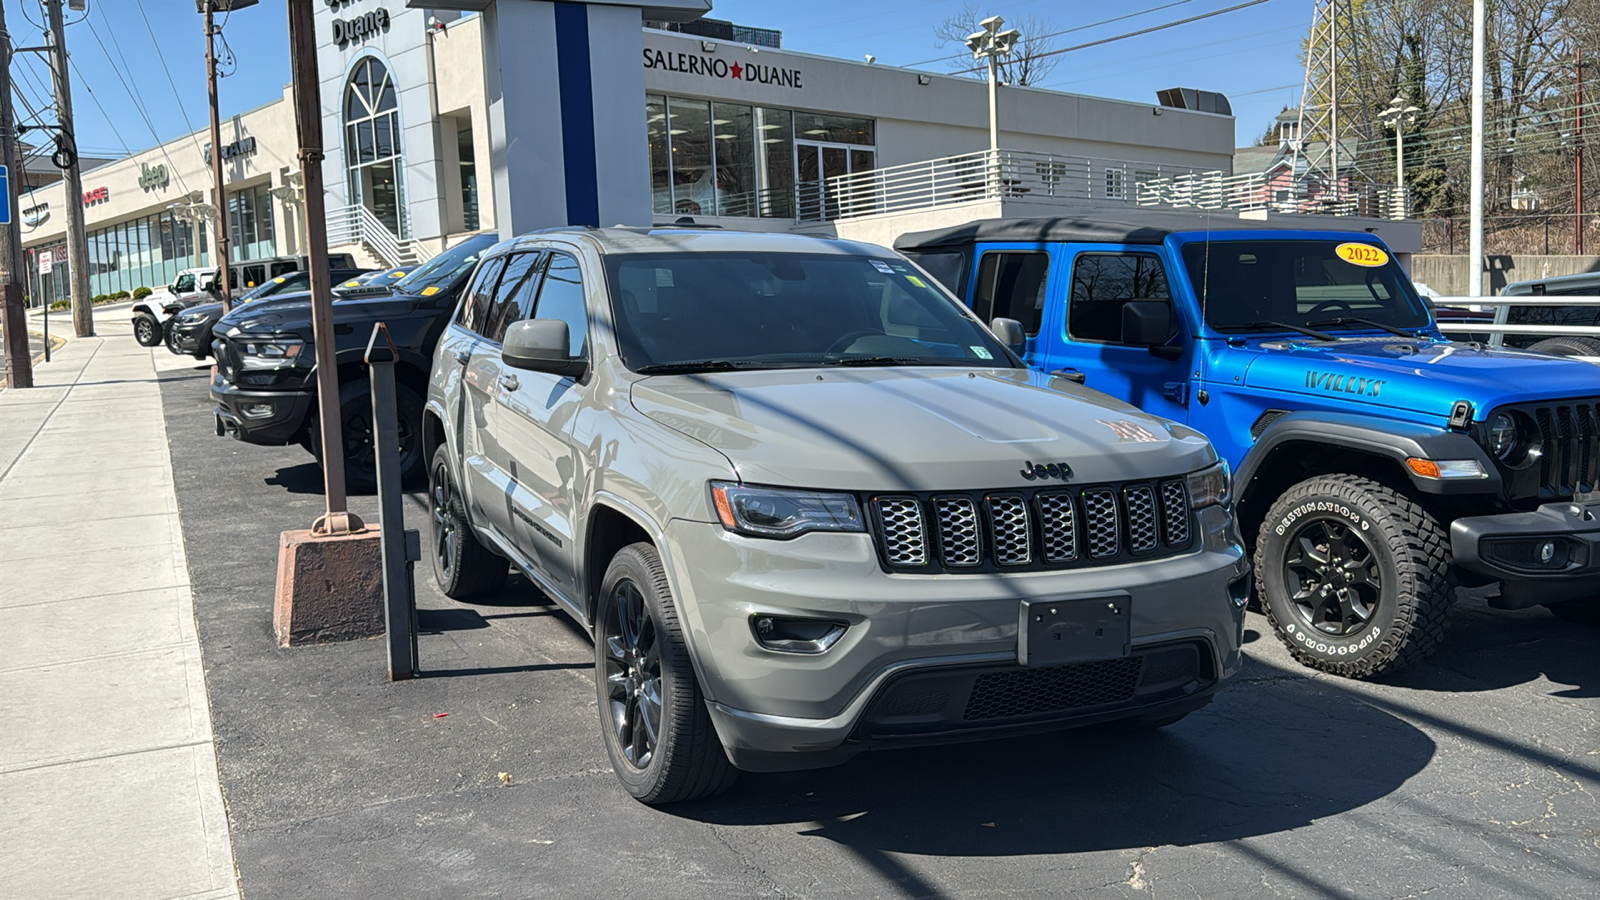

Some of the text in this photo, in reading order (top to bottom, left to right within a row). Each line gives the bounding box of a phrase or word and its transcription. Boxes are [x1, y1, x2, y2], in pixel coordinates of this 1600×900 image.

[332, 7, 386, 45] Duane
[643, 48, 802, 88] SALERNO DUANE
[138, 163, 166, 189] Jeep
[1346, 247, 1379, 262] 2022
[1305, 370, 1387, 397] WILLYS
[1020, 460, 1072, 481] Jeep
[1276, 502, 1360, 536] DESTINATION
